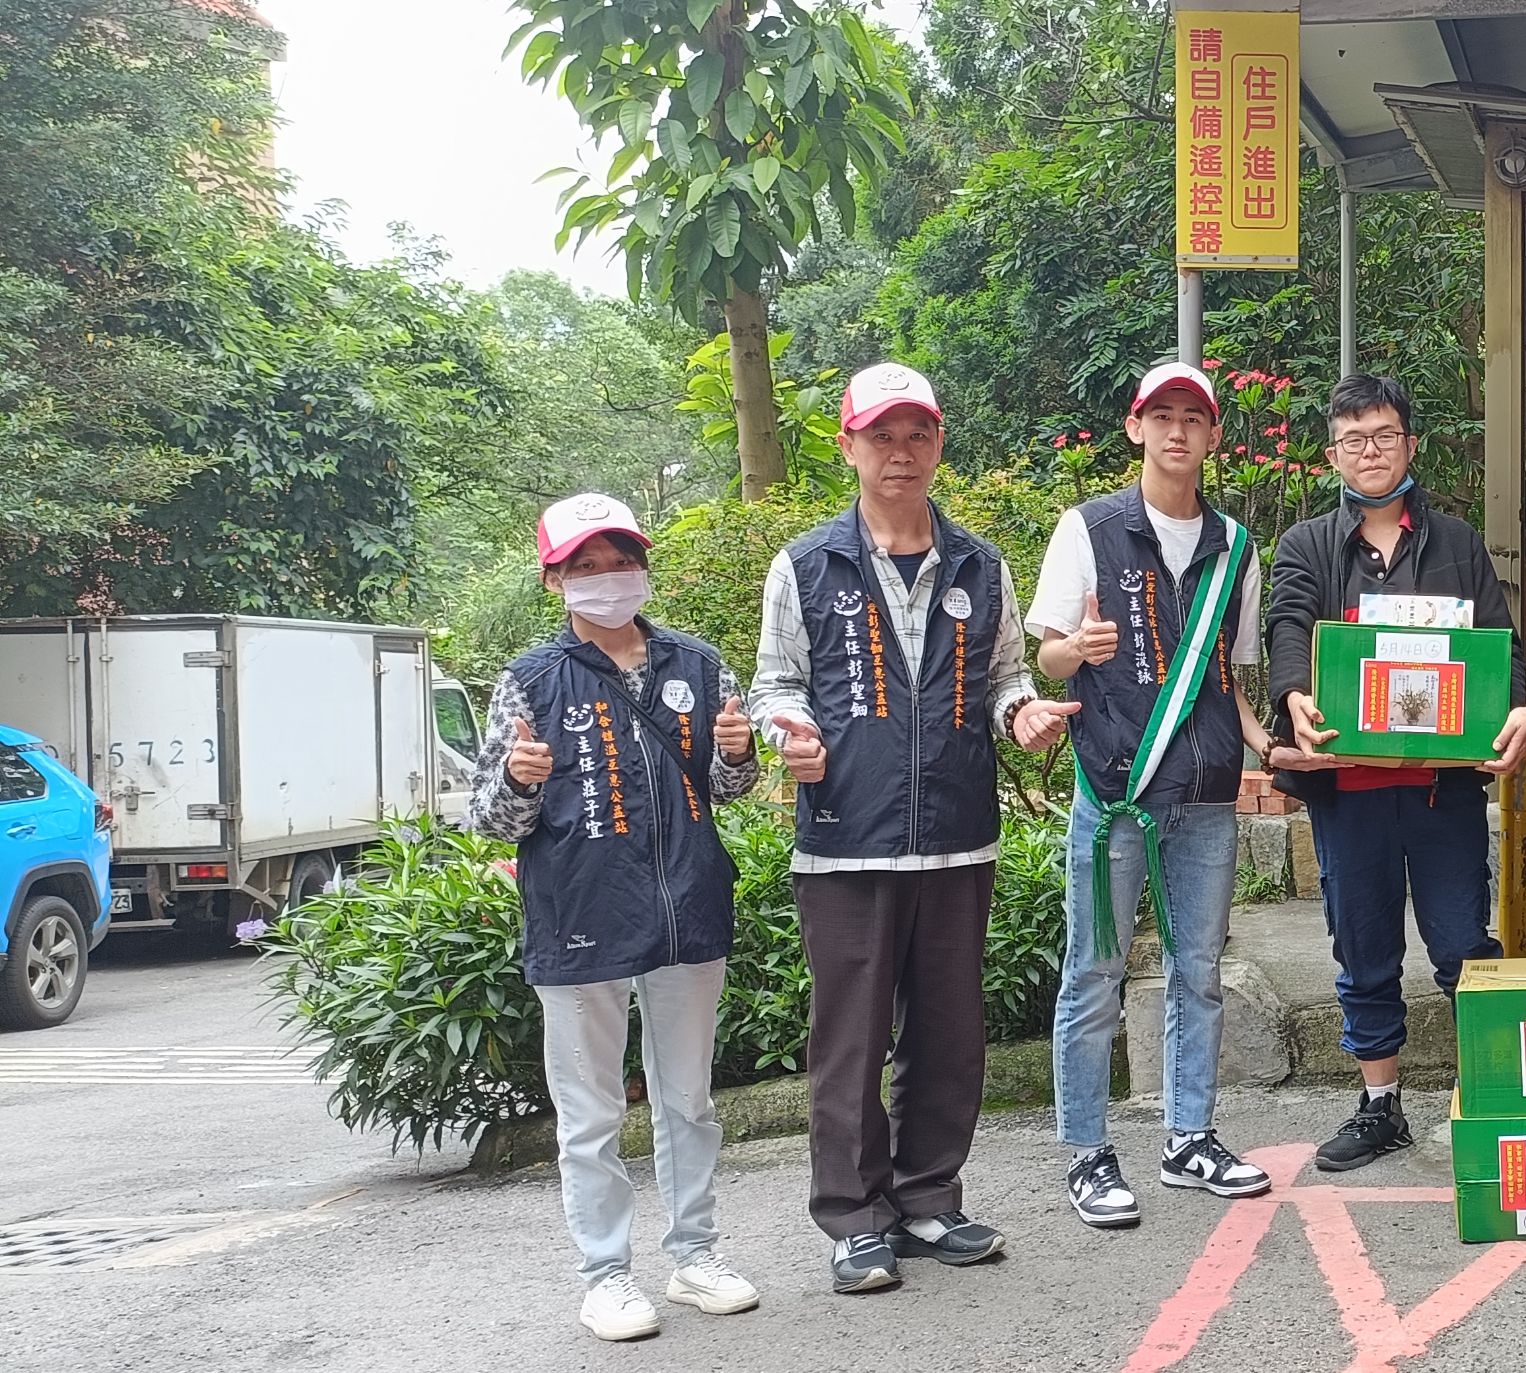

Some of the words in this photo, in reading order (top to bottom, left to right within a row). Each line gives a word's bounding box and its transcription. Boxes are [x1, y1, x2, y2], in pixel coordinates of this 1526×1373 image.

[1189, 28, 1223, 254] 請自備遙控器
[1242, 65, 1278, 220] 住戶進出
